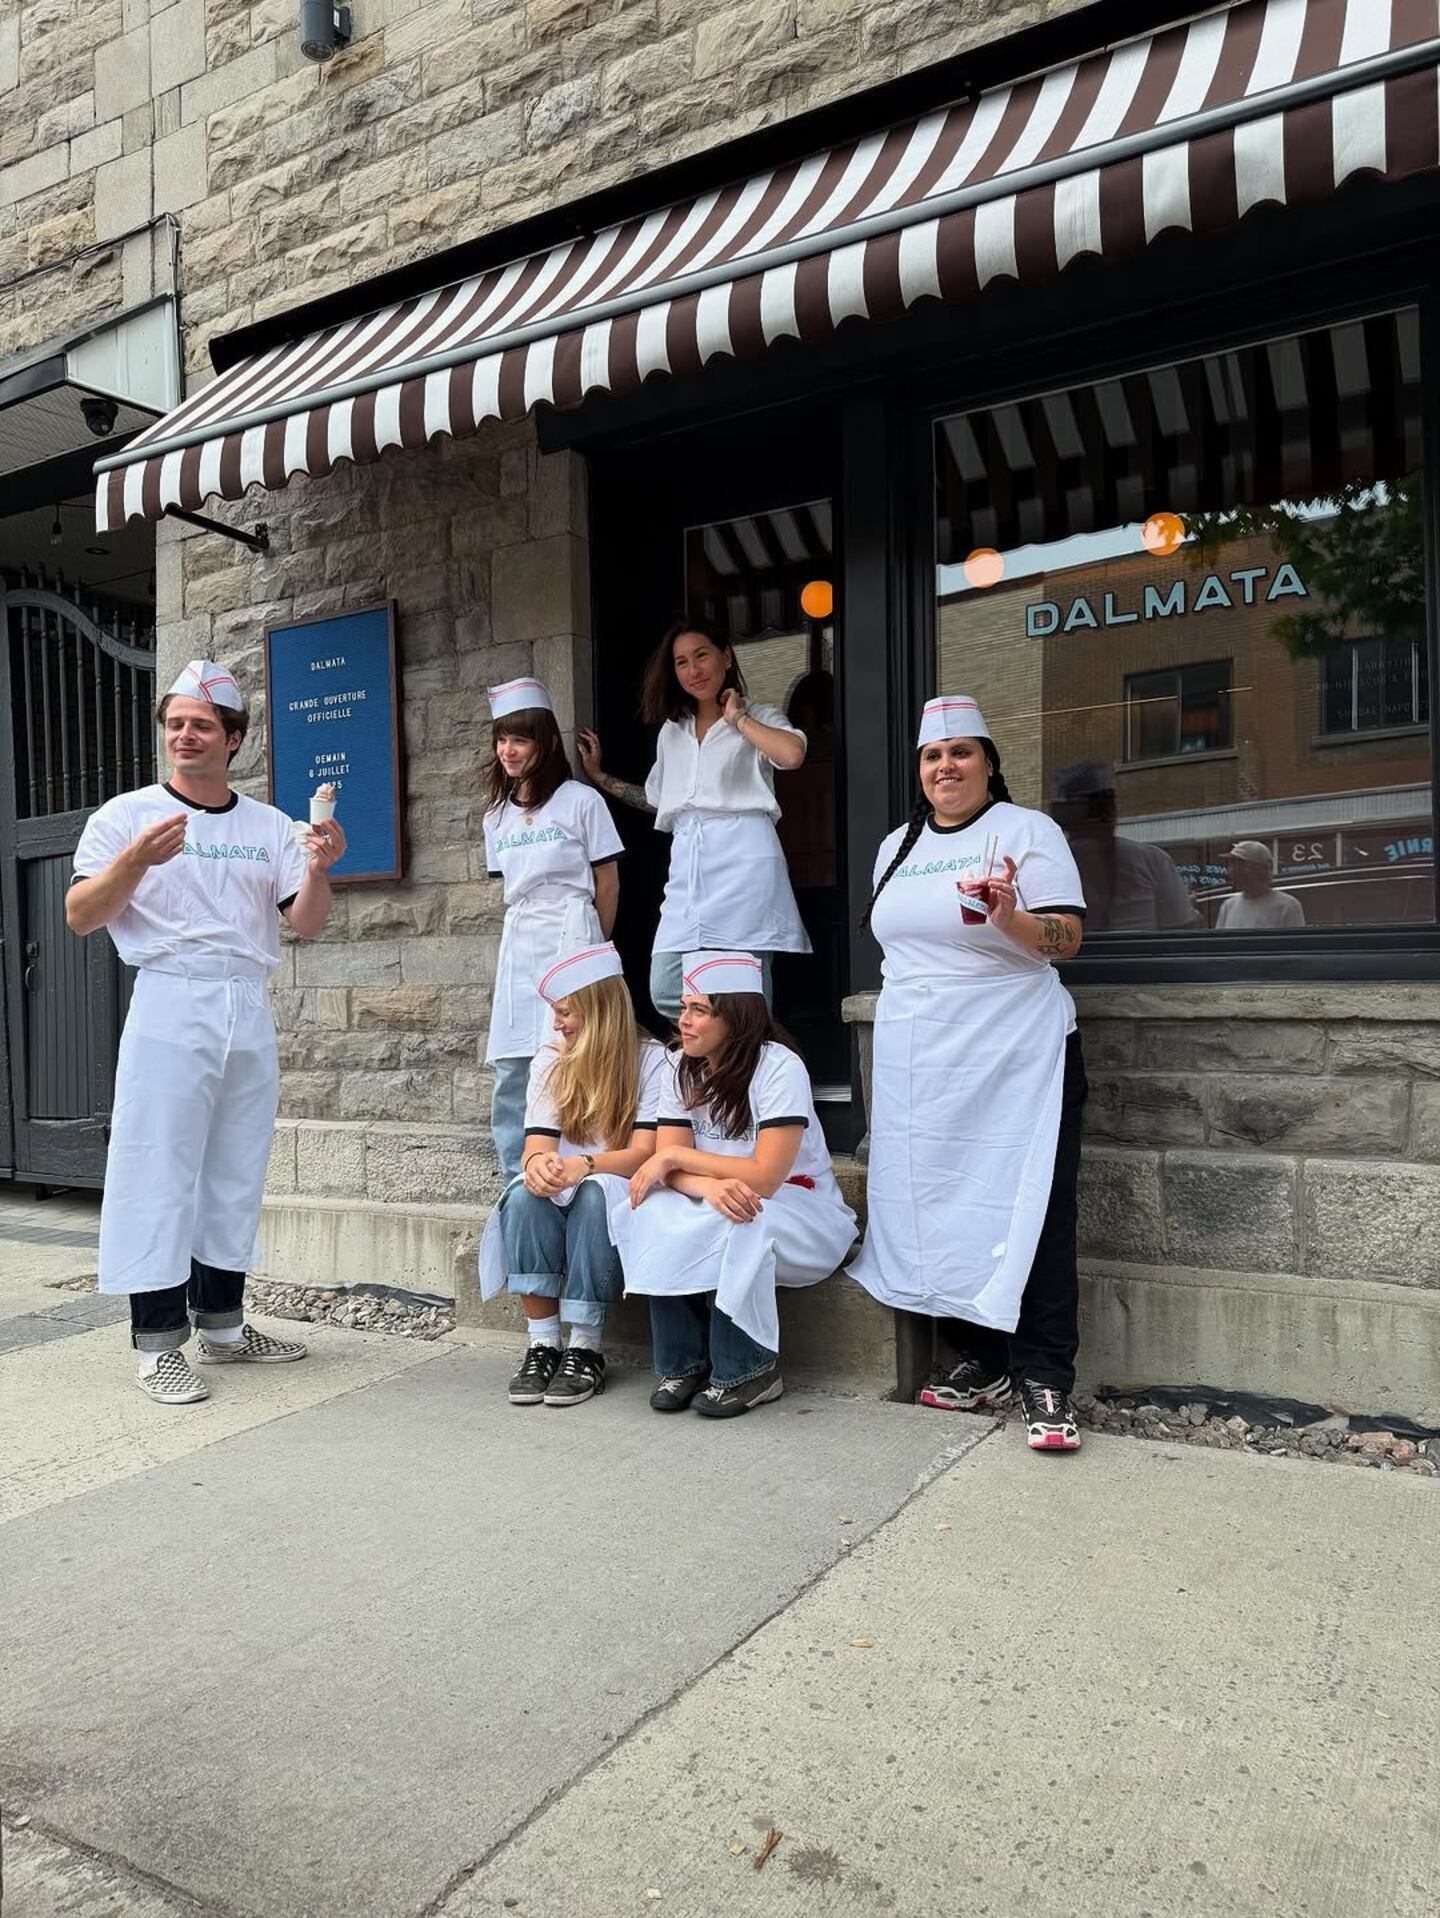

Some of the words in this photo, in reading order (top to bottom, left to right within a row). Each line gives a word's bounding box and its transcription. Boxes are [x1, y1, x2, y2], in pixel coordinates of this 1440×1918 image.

[1026, 563, 1309, 638] DALMATA
[310, 656, 346, 671] DALMATA
[288, 697, 319, 711] GRANDE
[323, 689, 367, 706] OUVERTURE
[307, 707, 352, 723] OFFICIELLE
[315, 752, 346, 764] DEMAIN
[317, 764, 350, 777] JUILLET
[182, 842, 270, 862] ALMATA
